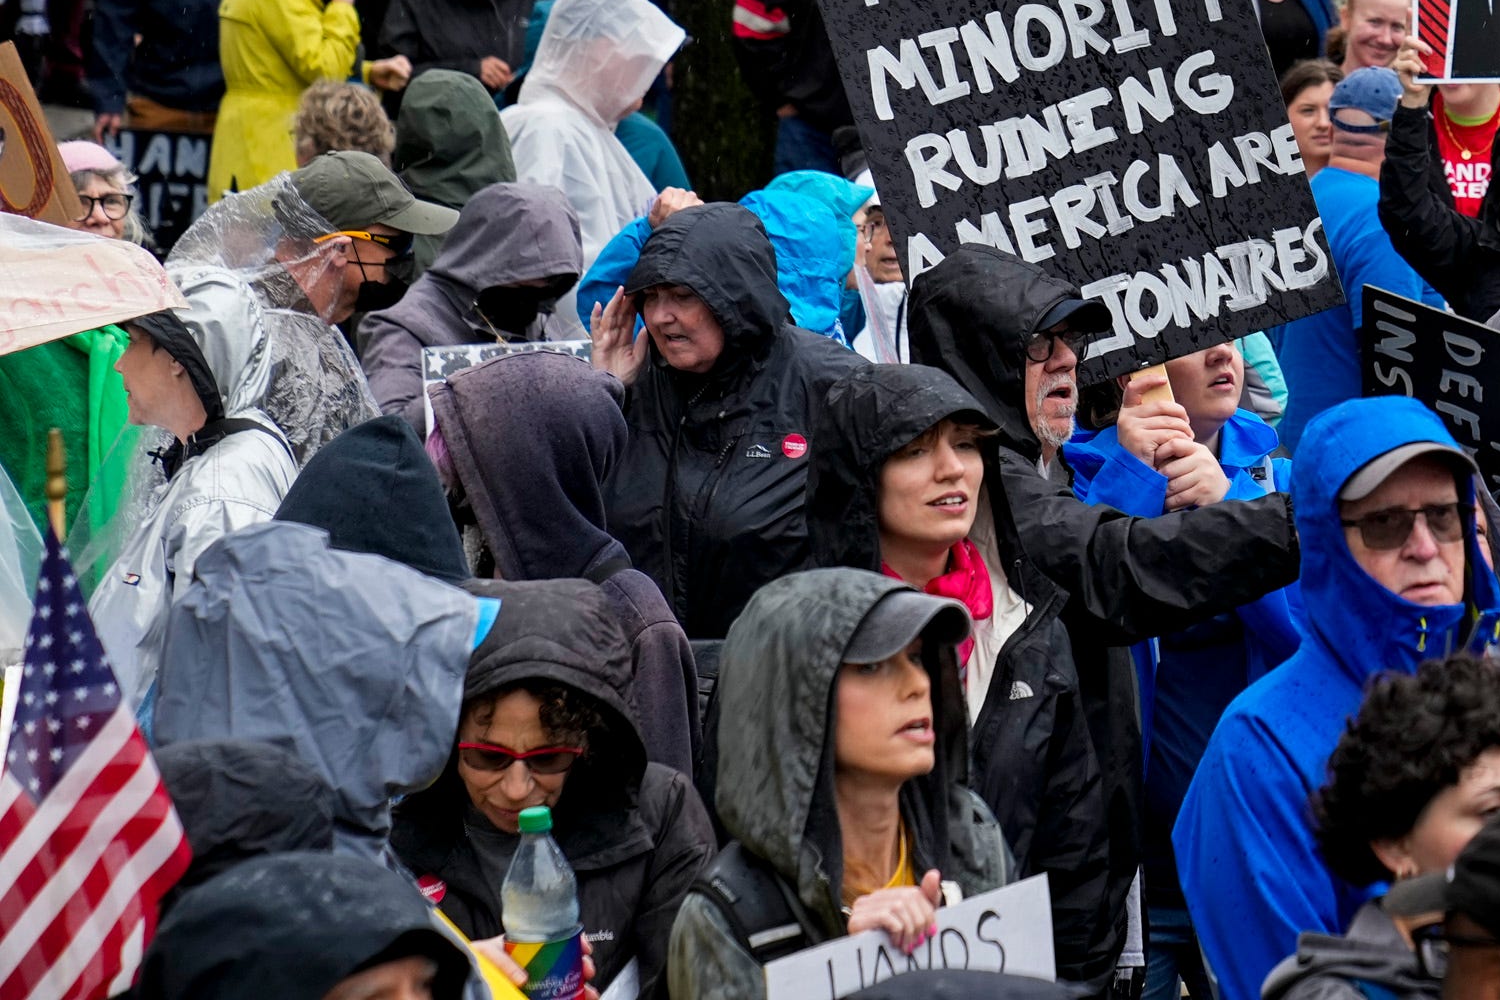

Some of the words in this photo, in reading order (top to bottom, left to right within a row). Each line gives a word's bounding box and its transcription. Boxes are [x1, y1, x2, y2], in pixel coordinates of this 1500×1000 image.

[903, 49, 1235, 209] RUINING
[1441, 159, 1492, 182] AND
[907, 153, 1201, 289] AMERICA
[1206, 122, 1306, 198] ARE
[1436, 329, 1486, 462] DEF
